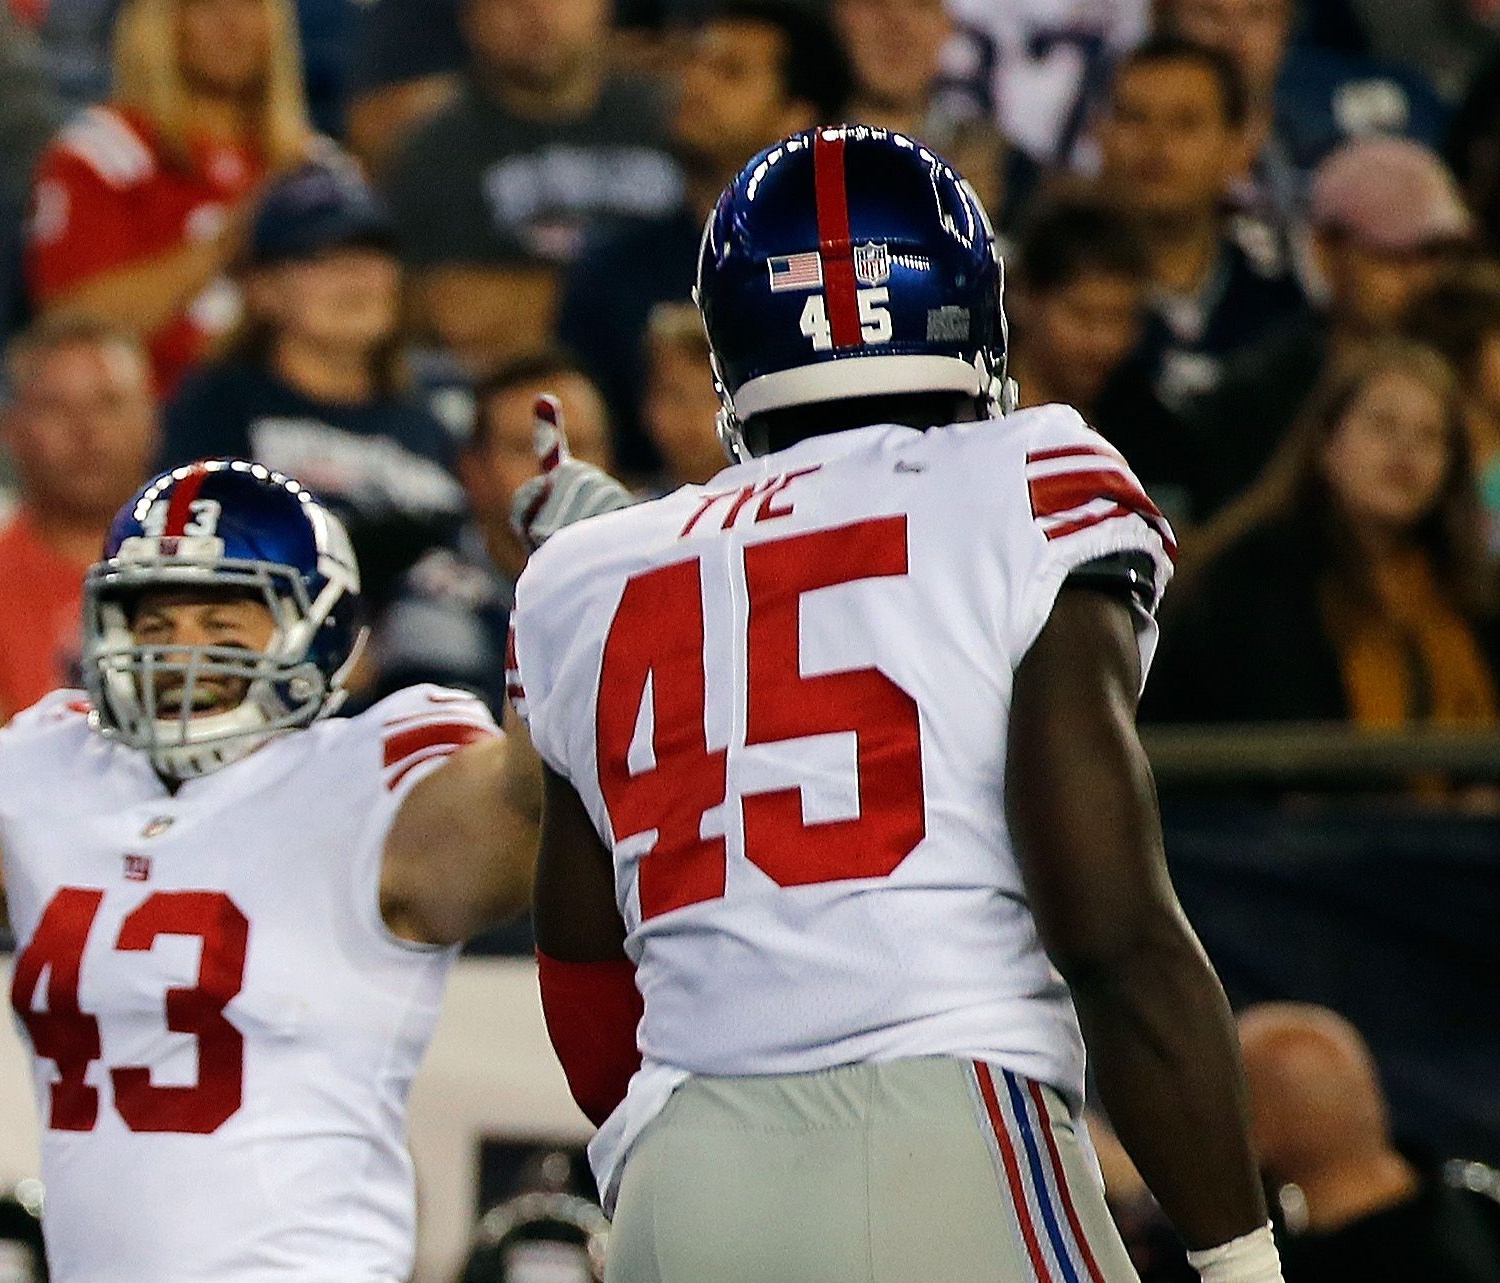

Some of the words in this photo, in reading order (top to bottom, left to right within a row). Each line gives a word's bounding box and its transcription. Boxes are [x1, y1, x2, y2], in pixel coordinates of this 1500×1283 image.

[799, 286, 893, 351] 45
[596, 513, 927, 921] 45
[10, 886, 251, 1134] 43
